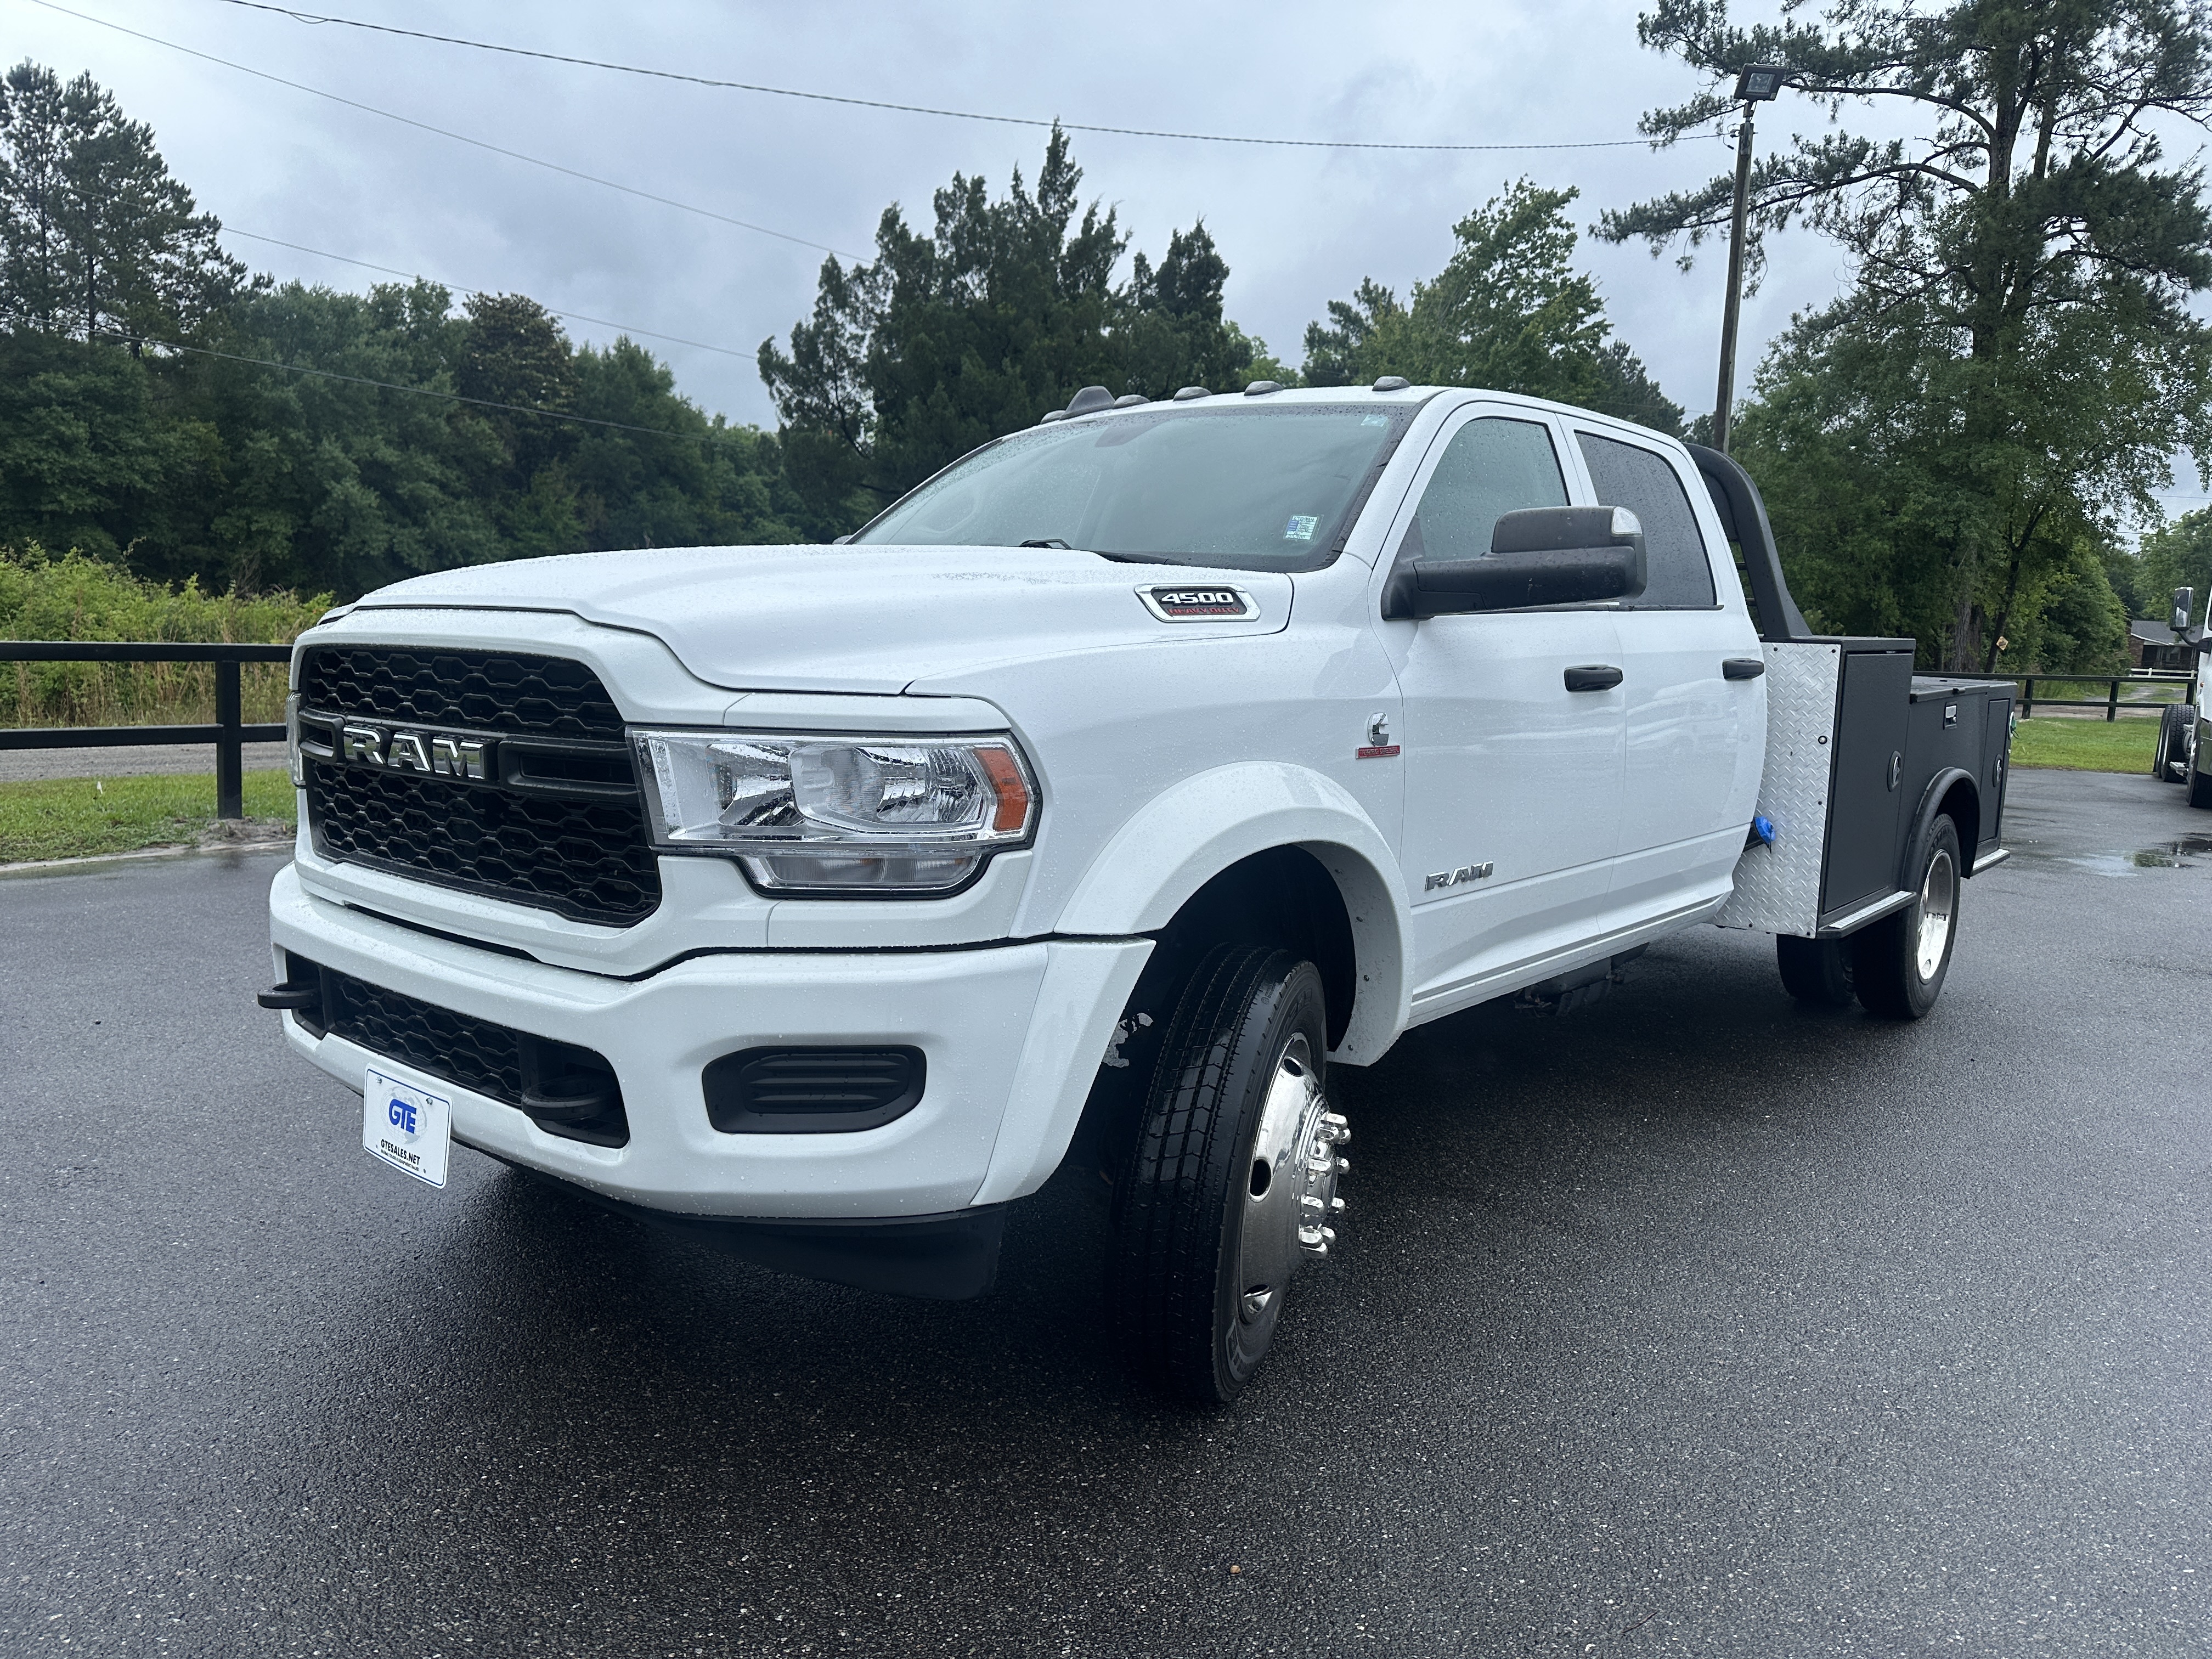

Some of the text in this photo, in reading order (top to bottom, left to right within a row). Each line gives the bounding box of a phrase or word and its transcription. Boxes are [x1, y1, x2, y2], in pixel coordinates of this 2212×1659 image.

[1160, 592, 1234, 604] 4500
[343, 726, 485, 780] RAM
[1425, 861, 1494, 891] RAM
[389, 1098, 417, 1134] GTE
[381, 1138, 421, 1166] GTESALES.NET
